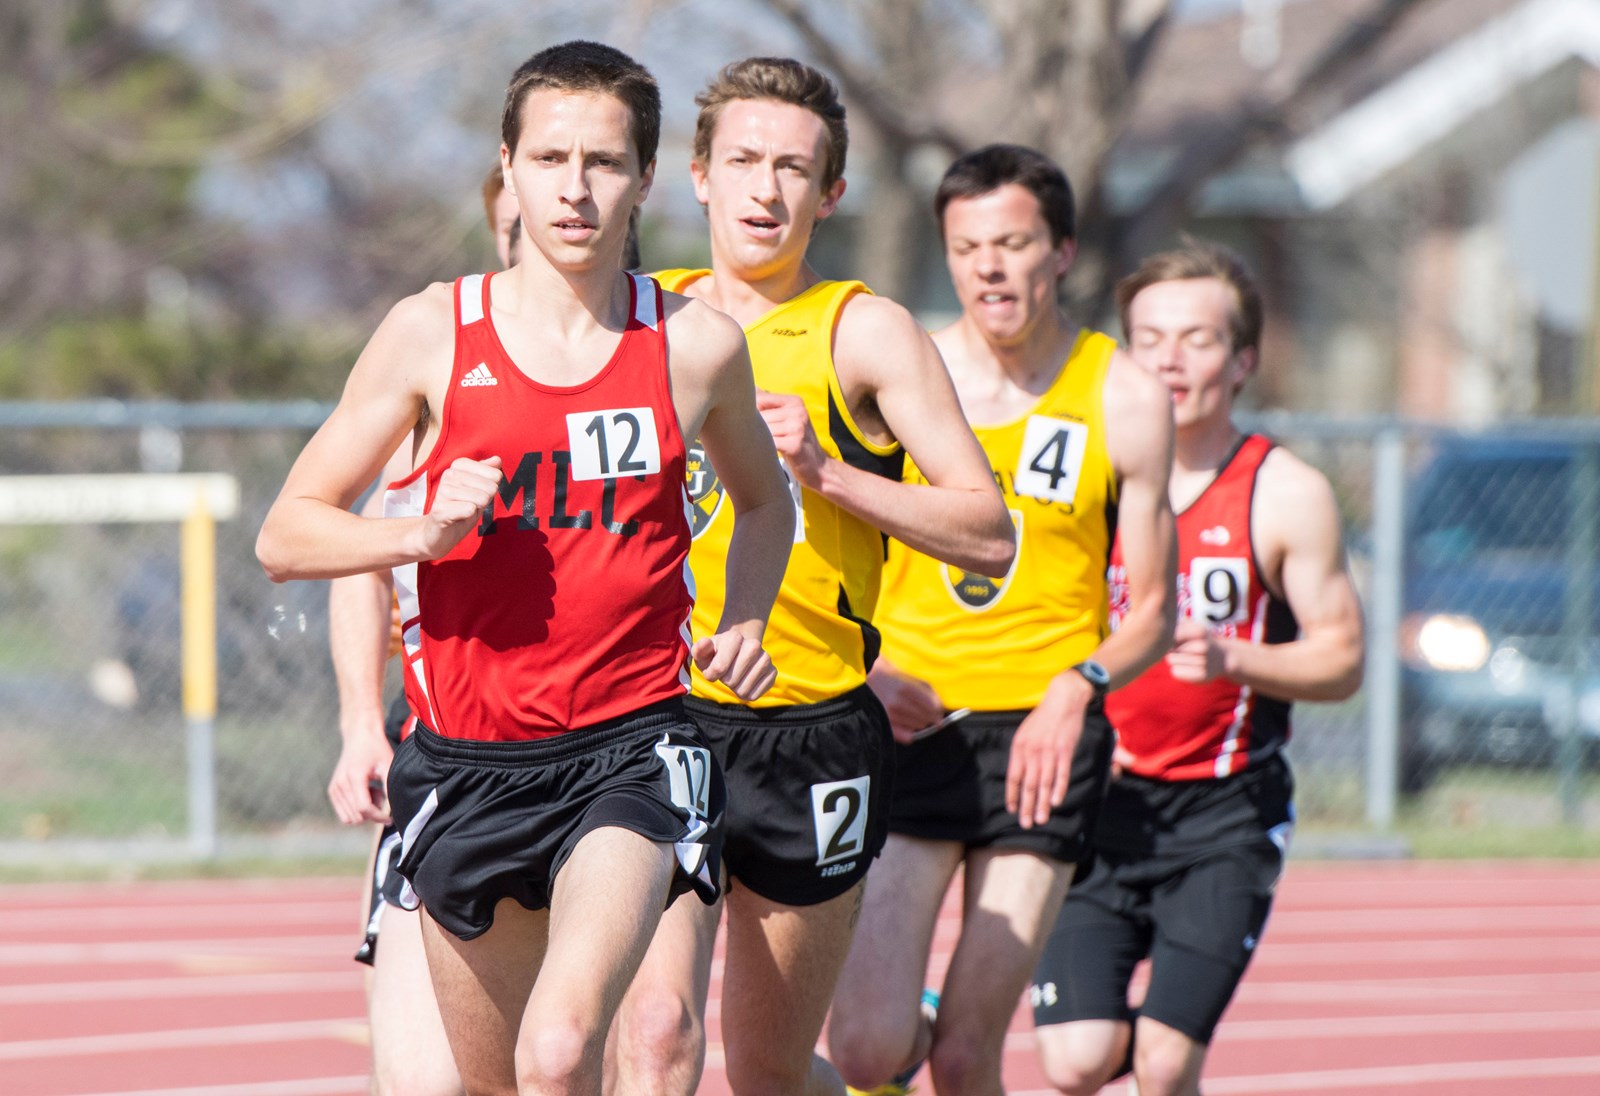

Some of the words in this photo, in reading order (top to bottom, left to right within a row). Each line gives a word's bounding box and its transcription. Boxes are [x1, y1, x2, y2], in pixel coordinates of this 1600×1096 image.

[461, 377, 498, 387] adidas
[585, 412, 647, 474] 12
[1029, 429, 1069, 490] 4
[1204, 569, 1239, 622] 9
[676, 749, 707, 813] 12
[822, 787, 862, 860] 2
